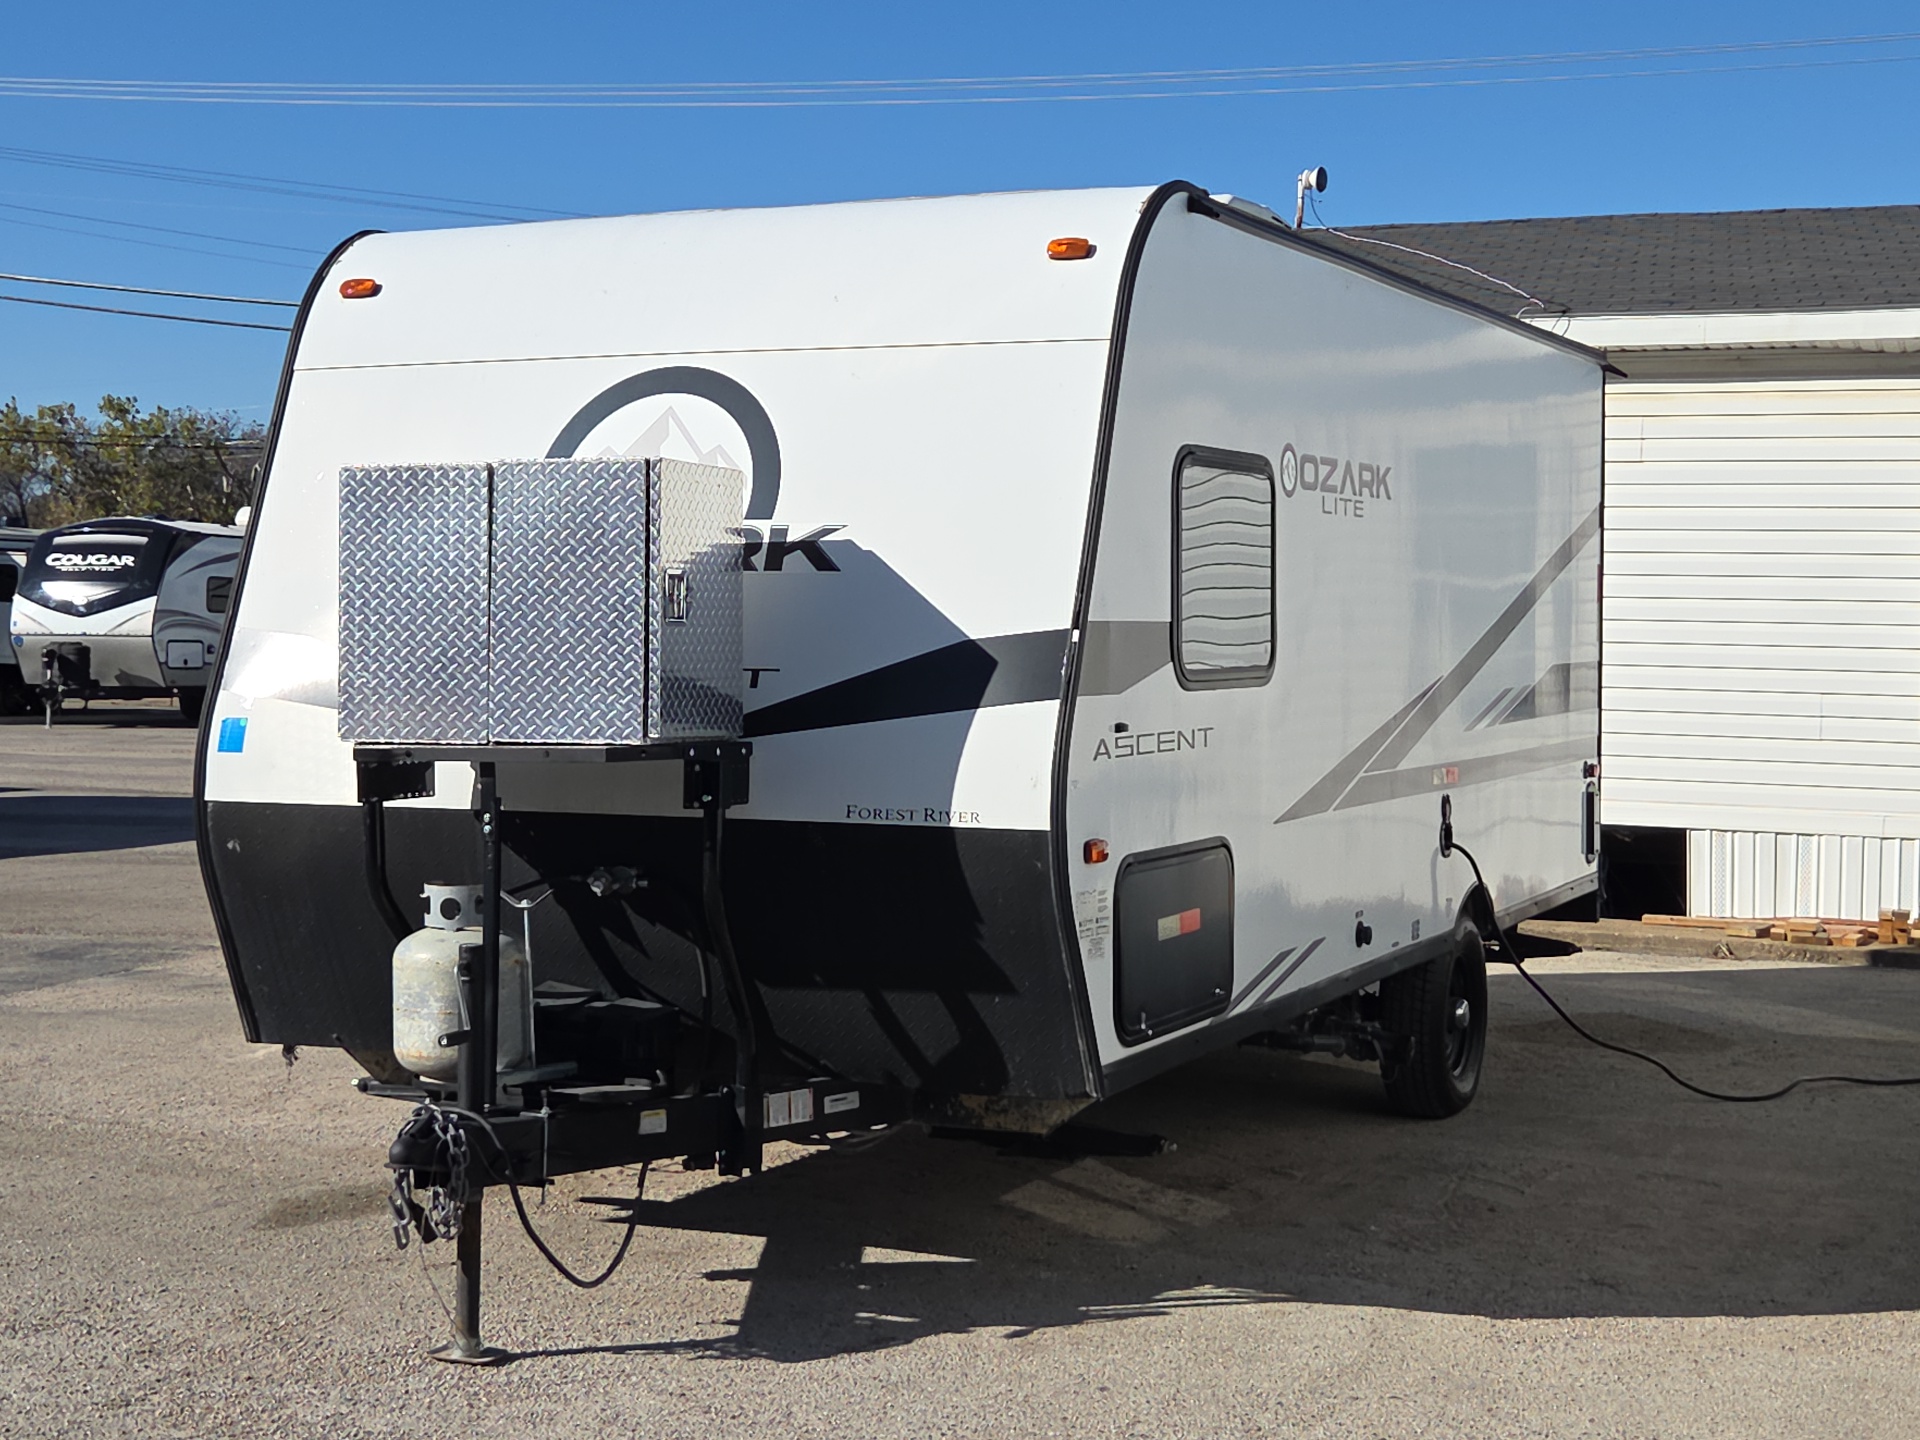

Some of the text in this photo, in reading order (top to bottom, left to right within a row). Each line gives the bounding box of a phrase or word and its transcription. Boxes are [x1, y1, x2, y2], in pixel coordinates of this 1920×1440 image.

[1300, 453, 1392, 501] OZARK
[1322, 495, 1364, 518] LITE
[45, 552, 135, 567] COUGAR
[1093, 727, 1214, 762] ASCENT
[846, 804, 982, 824] FOREST RIVER
